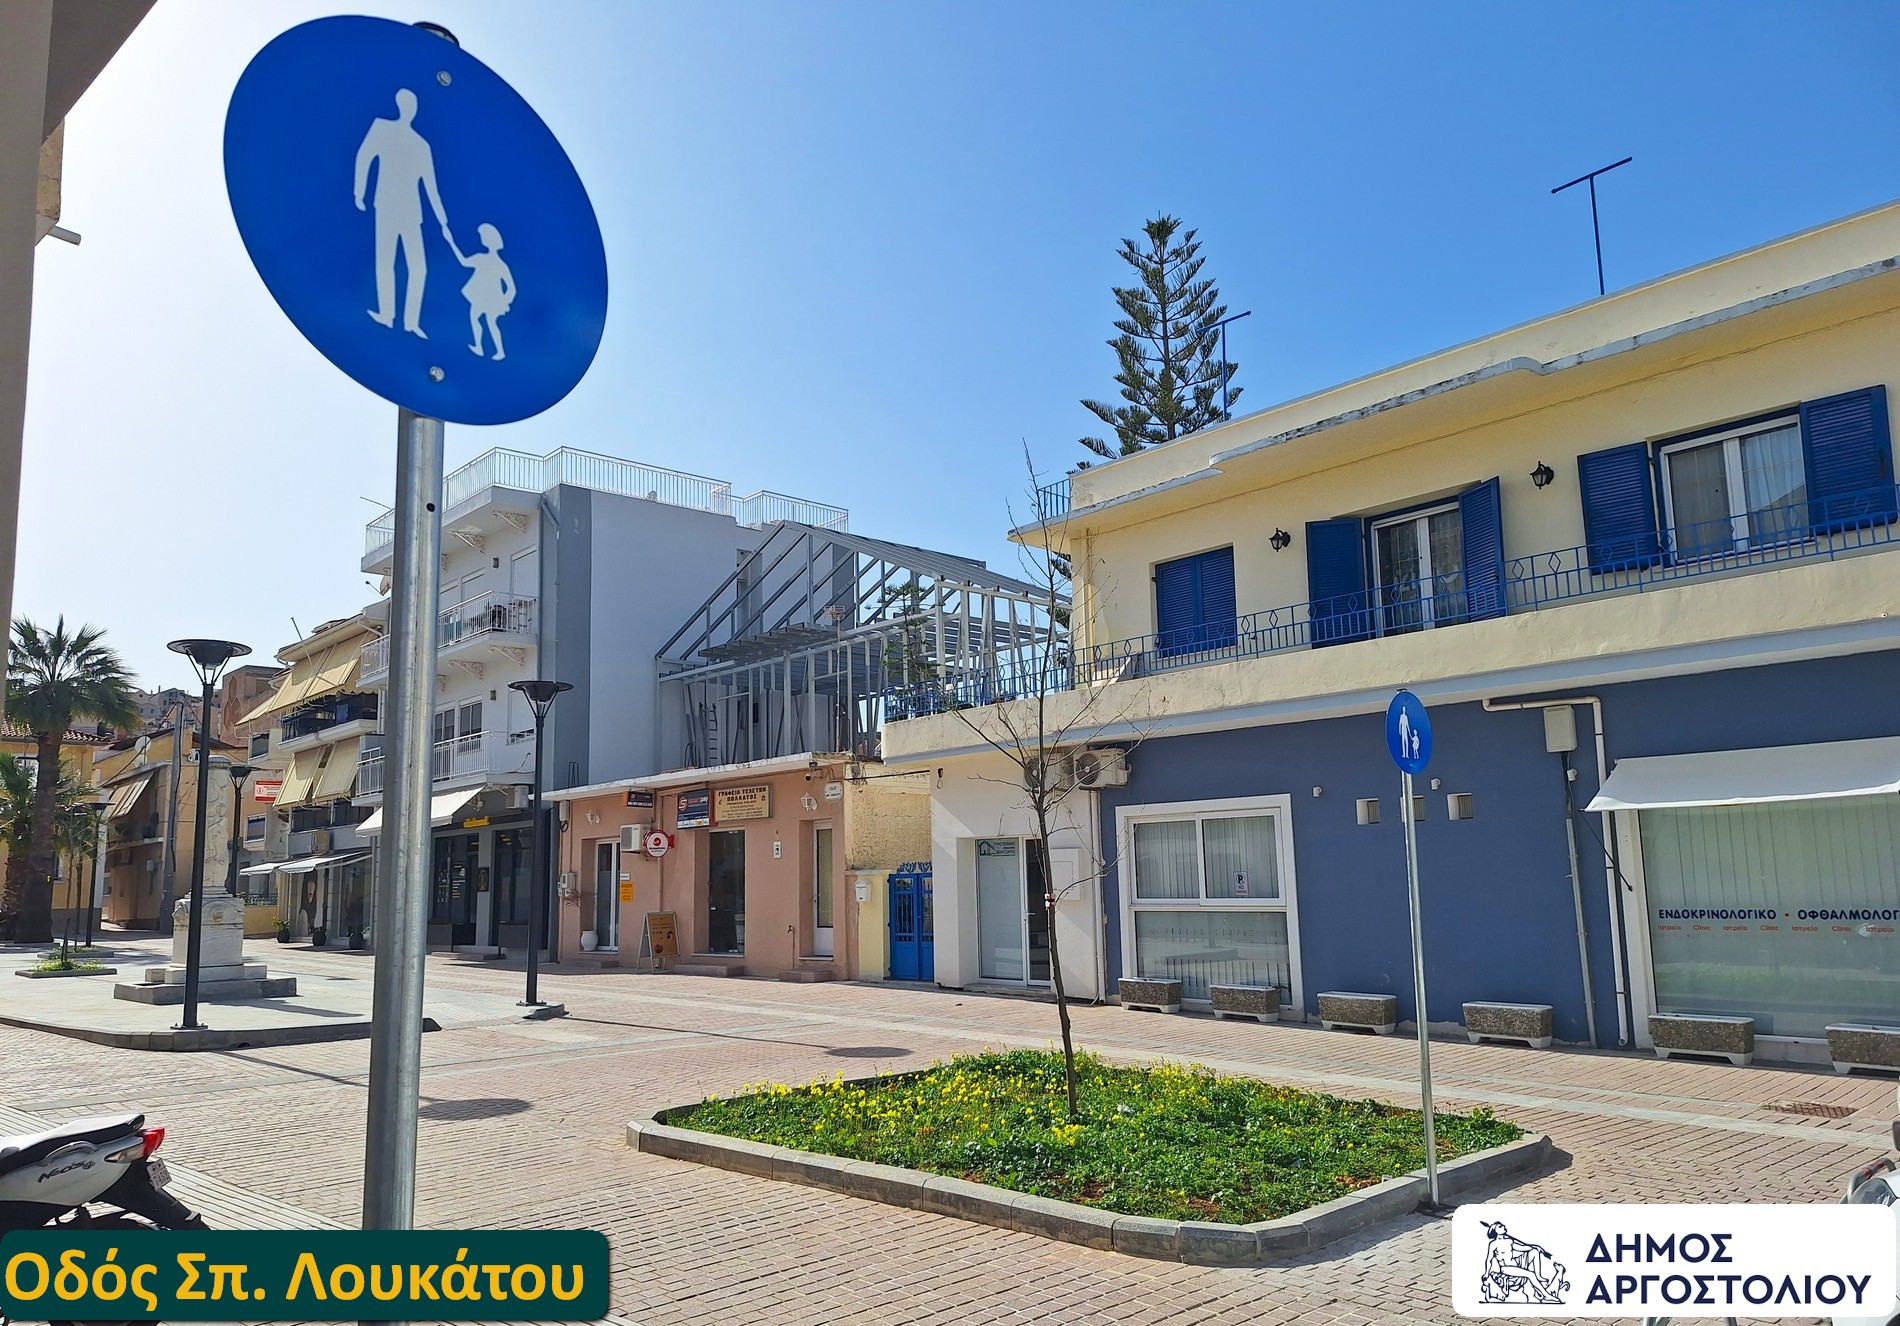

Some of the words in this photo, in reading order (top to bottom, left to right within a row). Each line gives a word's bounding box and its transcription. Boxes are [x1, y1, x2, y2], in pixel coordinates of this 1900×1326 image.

[718, 789, 741, 797] ΓΡΑΦΕΙΑ
[1658, 908, 1777, 920] ΕΝΔΟΚΡΙΝΟΛΟΓΙΚΟ
[1797, 909, 1900, 921] ΟΦΘΑΛΜΟΛΟΓ
